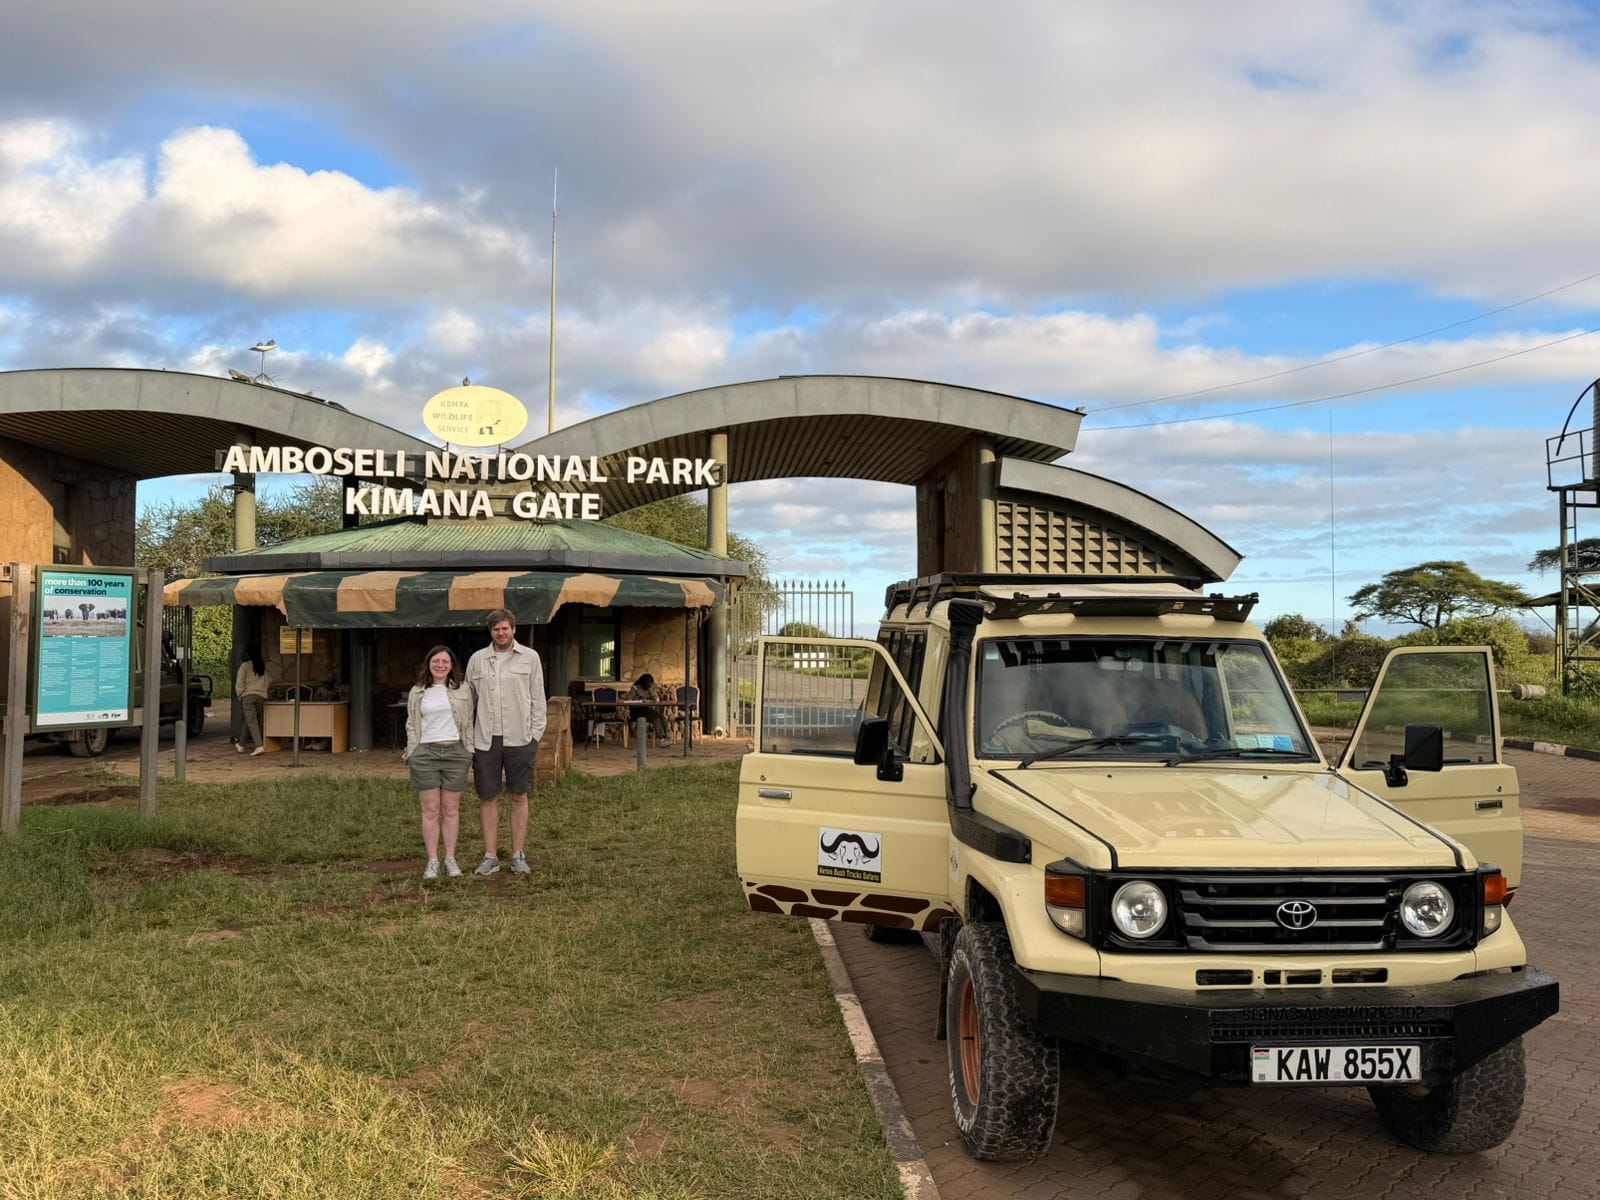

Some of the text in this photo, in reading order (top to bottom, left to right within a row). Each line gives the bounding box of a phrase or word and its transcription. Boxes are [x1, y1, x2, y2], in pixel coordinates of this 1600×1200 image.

[440, 400, 469, 408] KENYA
[432, 412, 473, 421] WILDLIFE
[438, 425, 470, 433] SERVICE
[222, 445, 717, 486] AMBOSELI NATIONAL PARK
[345, 487, 601, 521] KIMANA GATE
[44, 578, 125, 589] more than 100 years
[54, 587, 107, 595] conservation
[1277, 1048, 1412, 1080] KAW 855X
